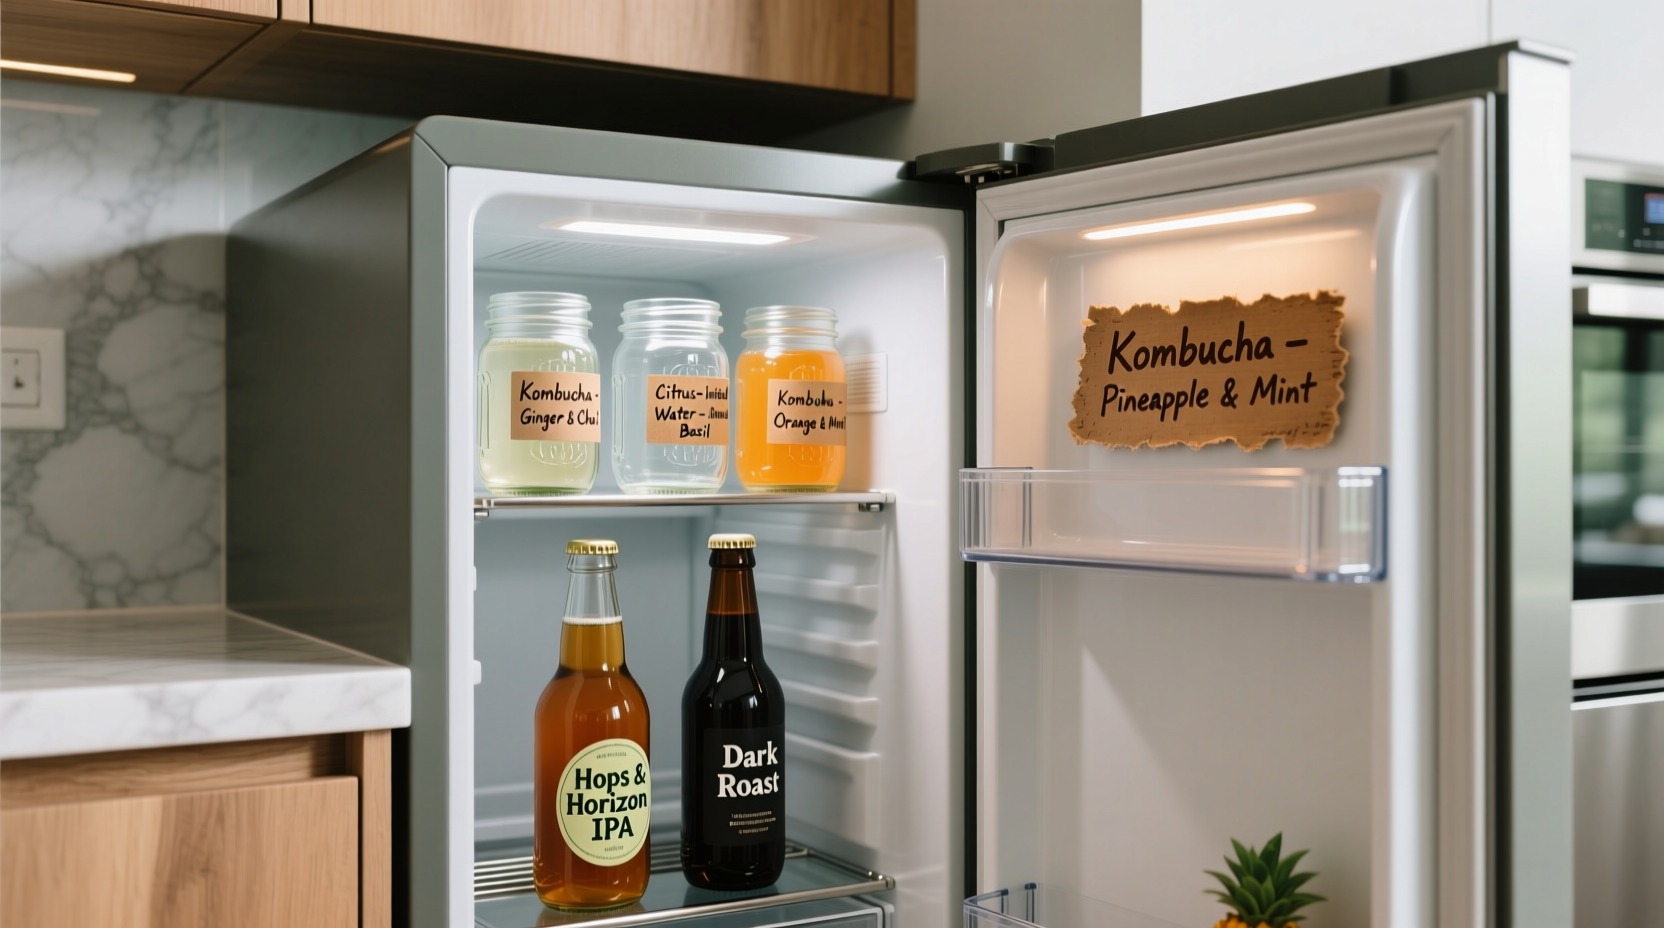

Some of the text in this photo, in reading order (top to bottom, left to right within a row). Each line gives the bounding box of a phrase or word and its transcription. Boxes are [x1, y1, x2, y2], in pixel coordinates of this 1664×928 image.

[1107, 320, 1275, 375] Kombucha
[519, 379, 592, 402] Kombucha
[1100, 371, 1318, 423] Pineapple & Mint
[520, 407, 564, 432] Ginger
[655, 405, 697, 421] Water
[773, 411, 817, 436] Orange
[679, 423, 711, 439] Basil
[722, 740, 778, 768] Dark
[574, 762, 646, 794] Hops &
[717, 771, 779, 798] Roast
[566, 791, 647, 815] Horizon
[591, 815, 634, 841] IPA
